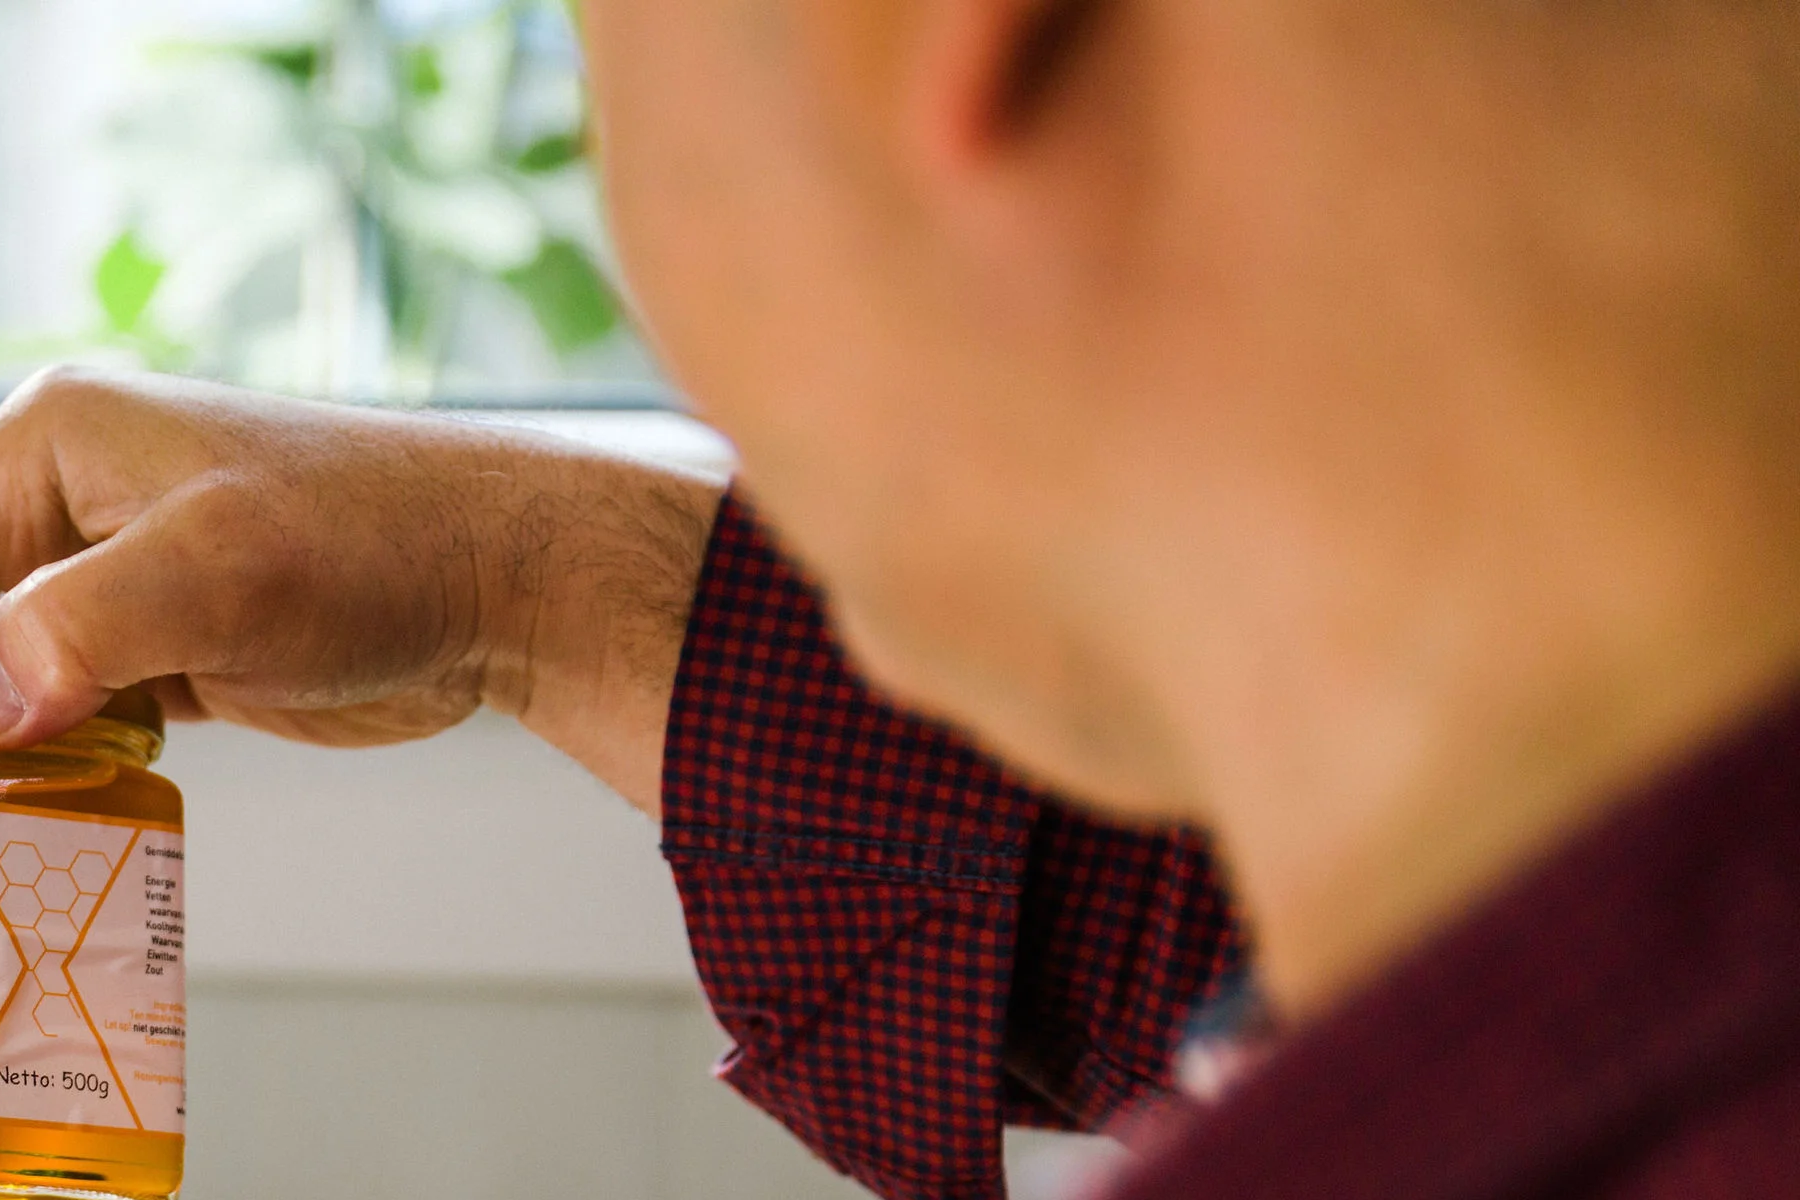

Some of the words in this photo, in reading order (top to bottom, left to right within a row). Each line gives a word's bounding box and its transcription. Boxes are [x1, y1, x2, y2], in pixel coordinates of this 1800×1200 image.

[145, 875, 176, 889] Energie
[145, 890, 172, 902] Vetten
[147, 949, 178, 962] Eiwitten
[145, 963, 163, 976] Zout
[133, 1023, 148, 1033] niet
[149, 1025, 181, 1037] geschikt
[62, 1071, 109, 1099] 500g
